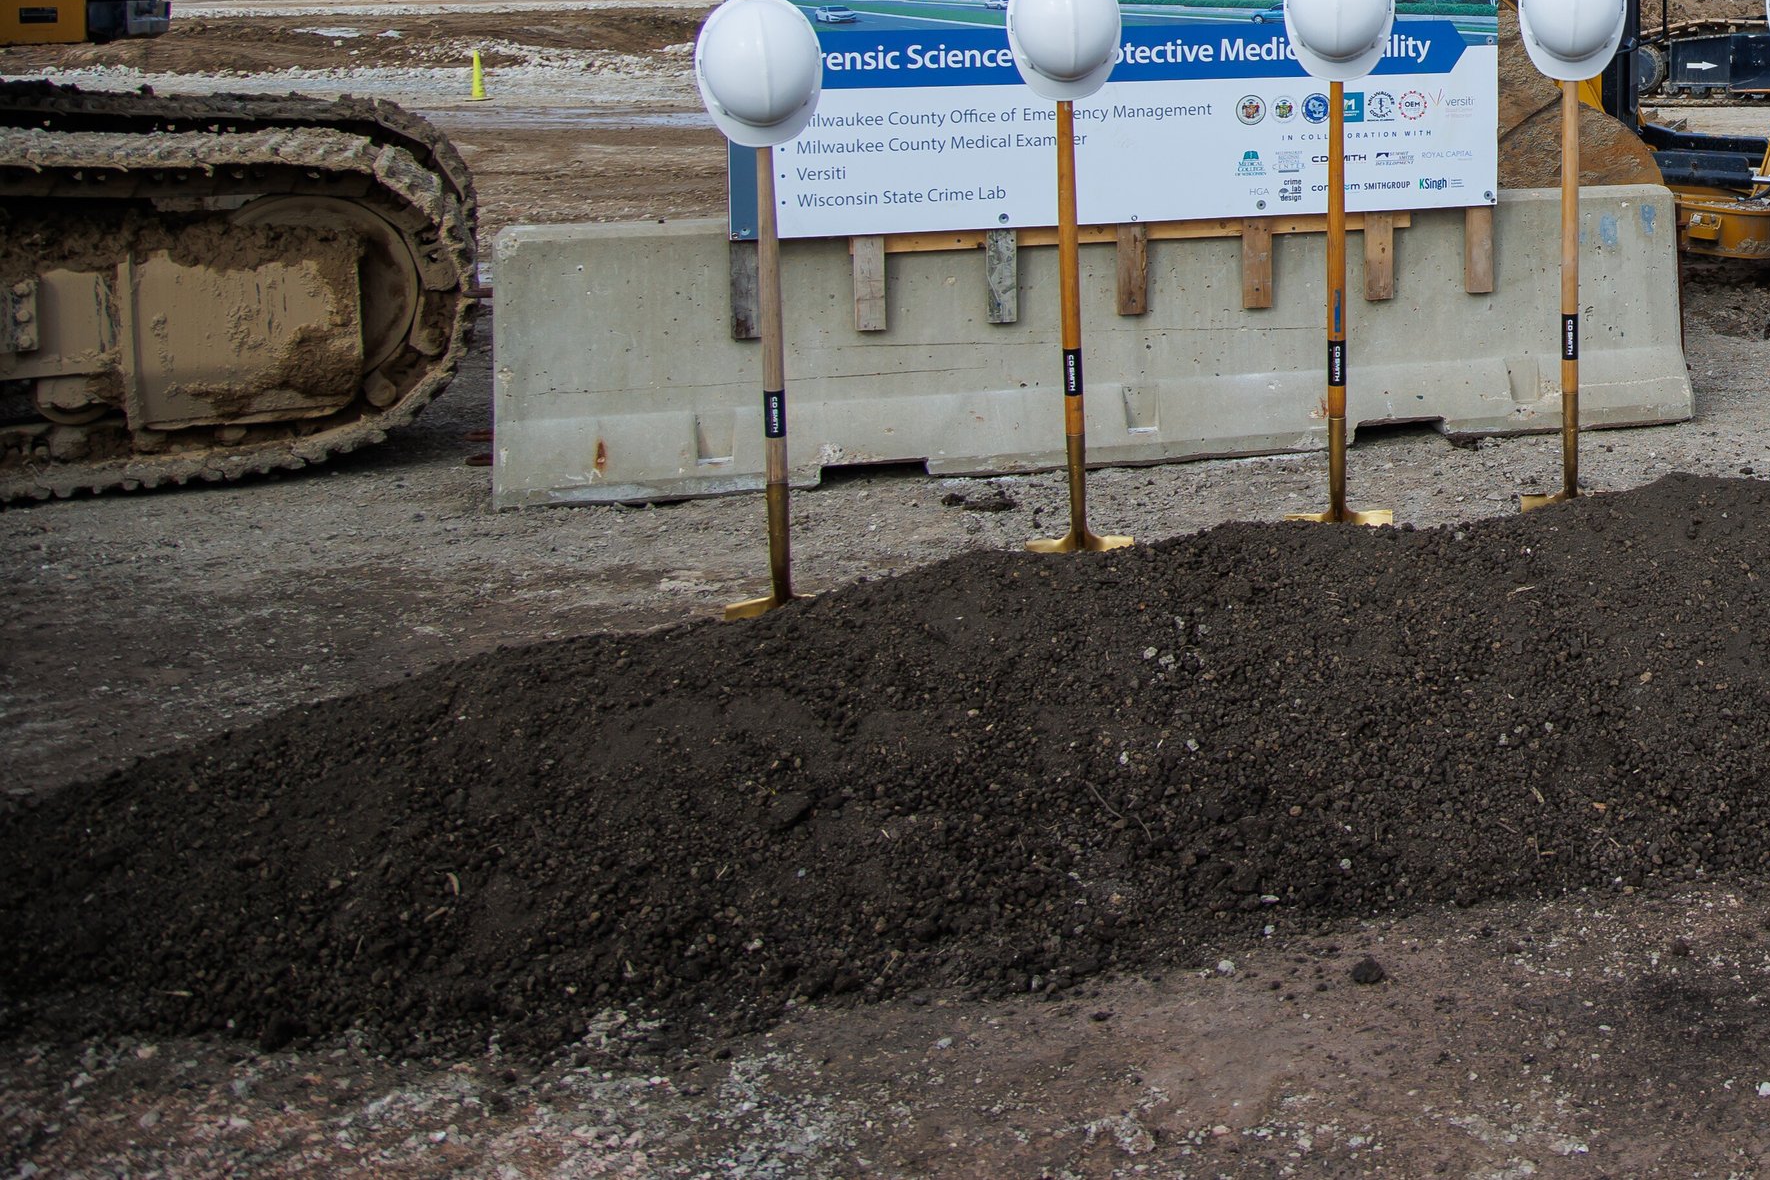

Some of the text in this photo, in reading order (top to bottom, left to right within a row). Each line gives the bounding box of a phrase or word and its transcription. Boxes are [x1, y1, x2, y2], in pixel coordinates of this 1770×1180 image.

[906, 44, 1014, 69] Science
[1220, 36, 1298, 62] Medic
[1381, 34, 1431, 64] ility
[807, 103, 1212, 128] ilwaukee County Office of Emeency Management
[1369, 109, 1392, 119] COUNTY
[1300, 131, 1397, 140] COLLORATION
[796, 134, 1087, 154] Milwaukee County Medical Examer
[1343, 154, 1367, 162] MITH
[796, 166, 847, 181] Versiti
[1364, 181, 1411, 190] SMITHGROUP
[1419, 177, 1447, 190] KSingh
[797, 185, 1007, 208] Wisconsin State Crime Lab
[1249, 187, 1270, 196] HGA
[1280, 194, 1302, 202] design
